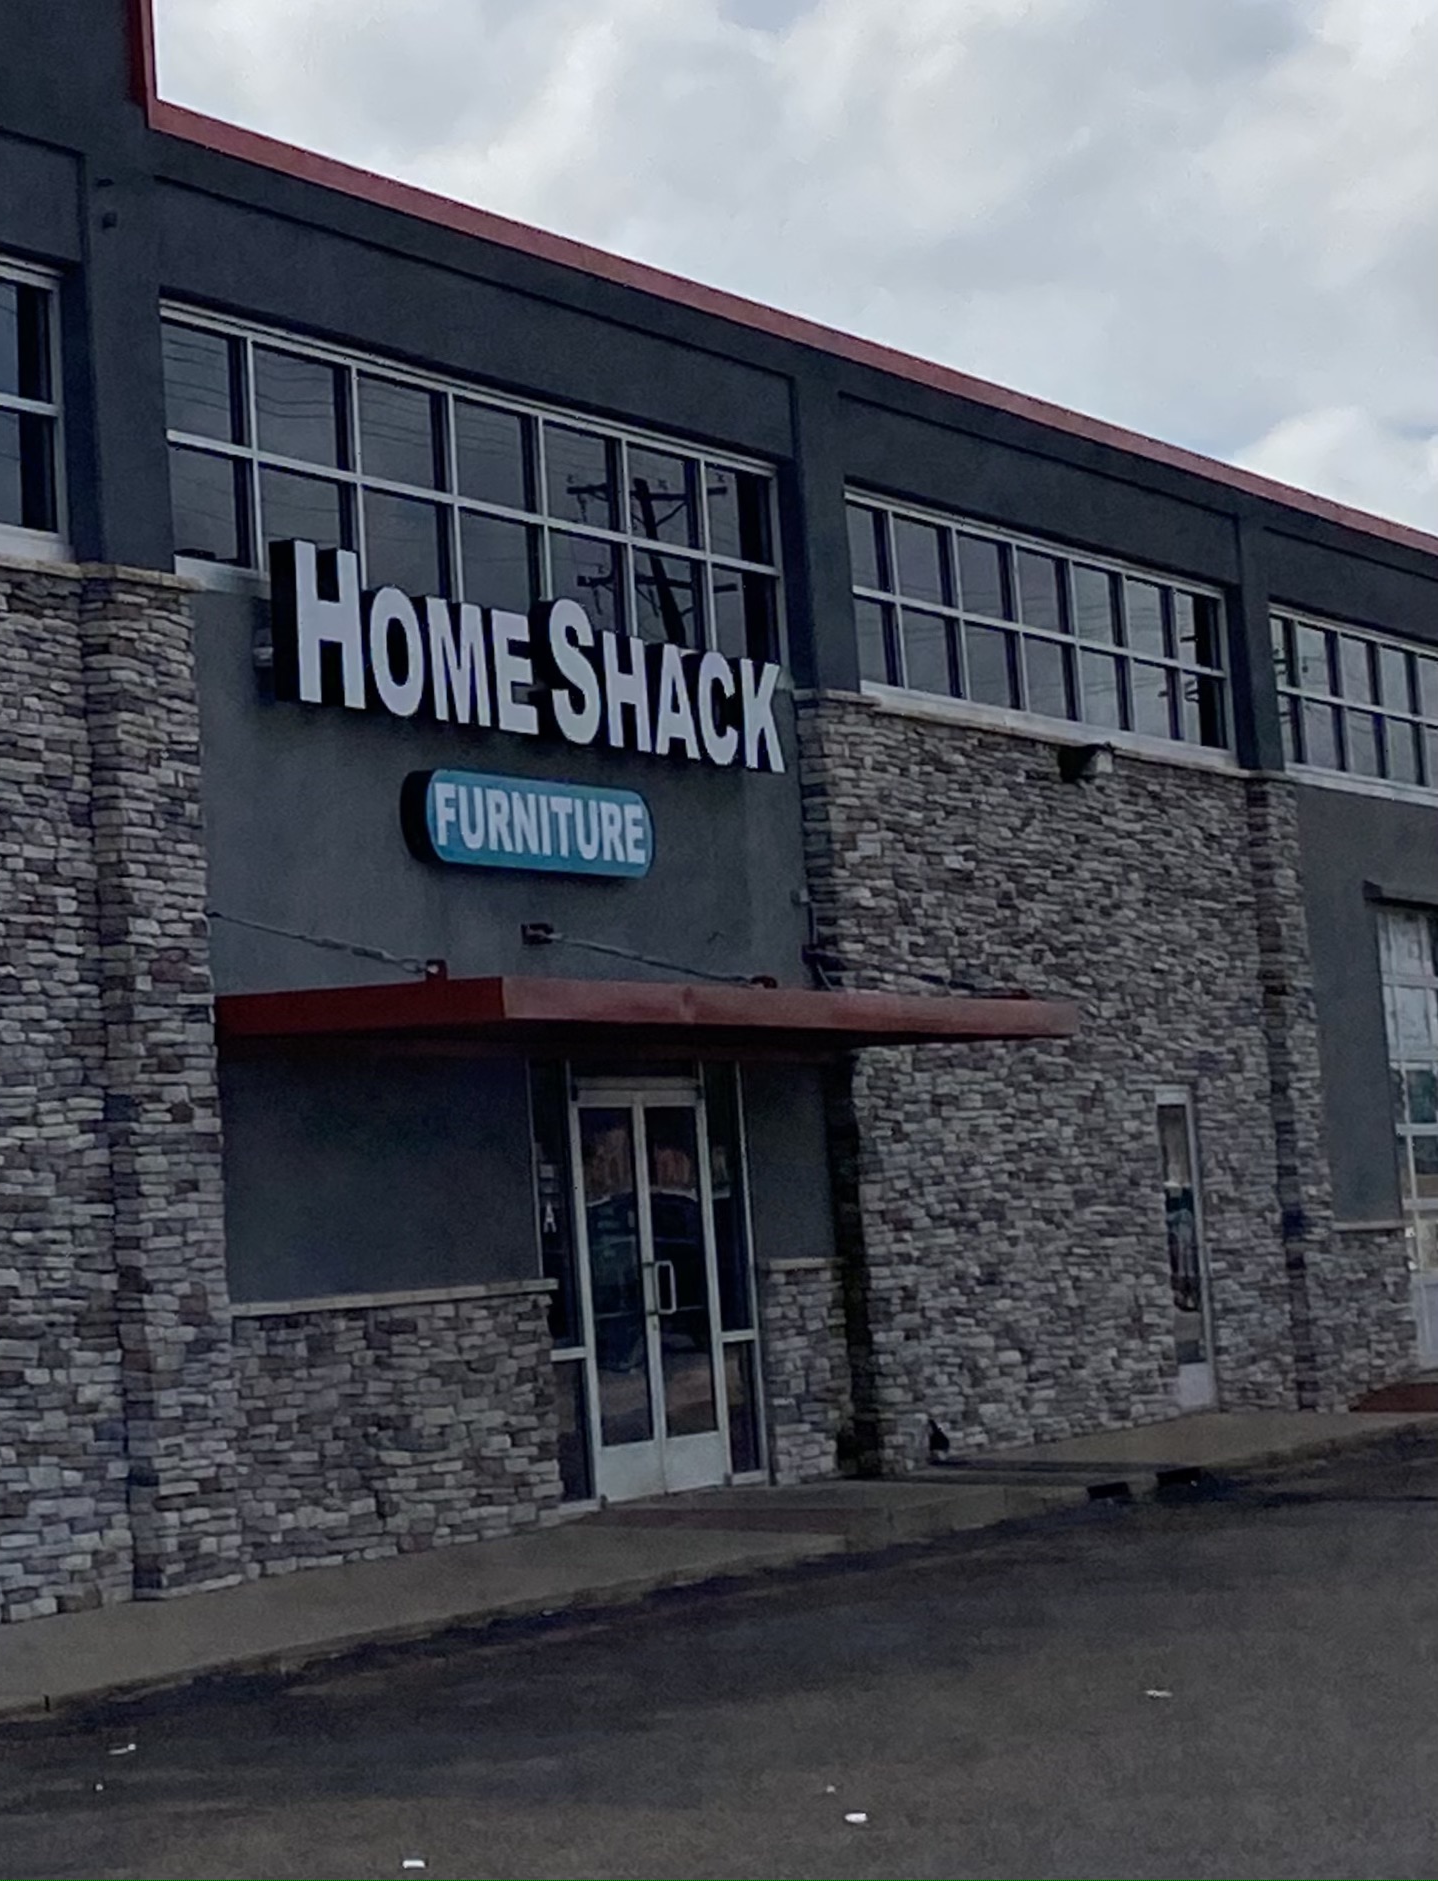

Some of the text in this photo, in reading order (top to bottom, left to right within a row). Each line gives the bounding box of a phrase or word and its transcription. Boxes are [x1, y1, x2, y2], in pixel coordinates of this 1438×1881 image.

[294, 540, 786, 773] HOME SHACK
[435, 783, 646, 864] FURNITURE
